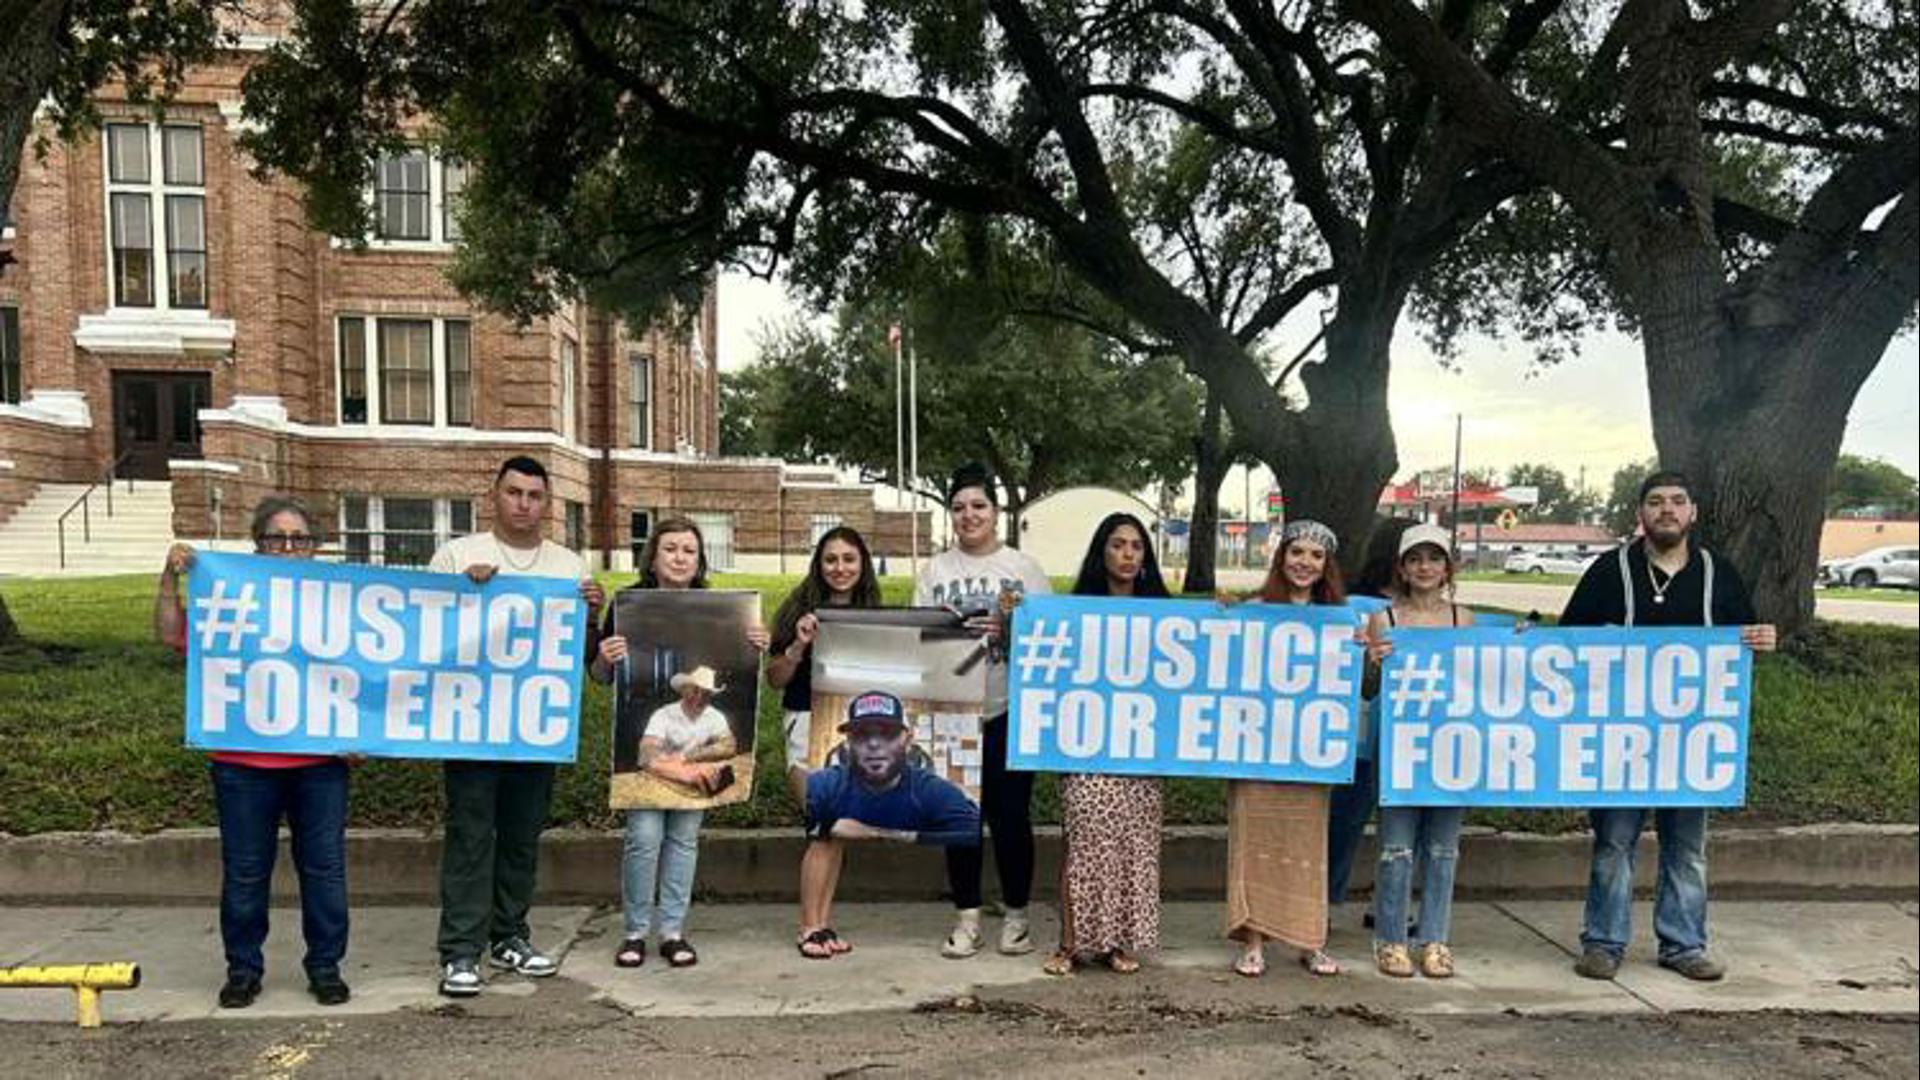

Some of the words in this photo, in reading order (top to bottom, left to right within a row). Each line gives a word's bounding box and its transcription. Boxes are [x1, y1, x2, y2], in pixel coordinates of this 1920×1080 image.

[197, 577, 575, 672] #JUSTICE
[1018, 614, 1356, 696] #JUSTICE
[202, 657, 361, 739] FOR
[384, 669, 572, 747] ERIC
[1389, 645, 1741, 720] #JUSTICE
[1019, 688, 1157, 760] FOR
[1176, 694, 1350, 769] ERIC
[1392, 722, 1537, 792] FOR
[1558, 722, 1739, 793] ERIC
